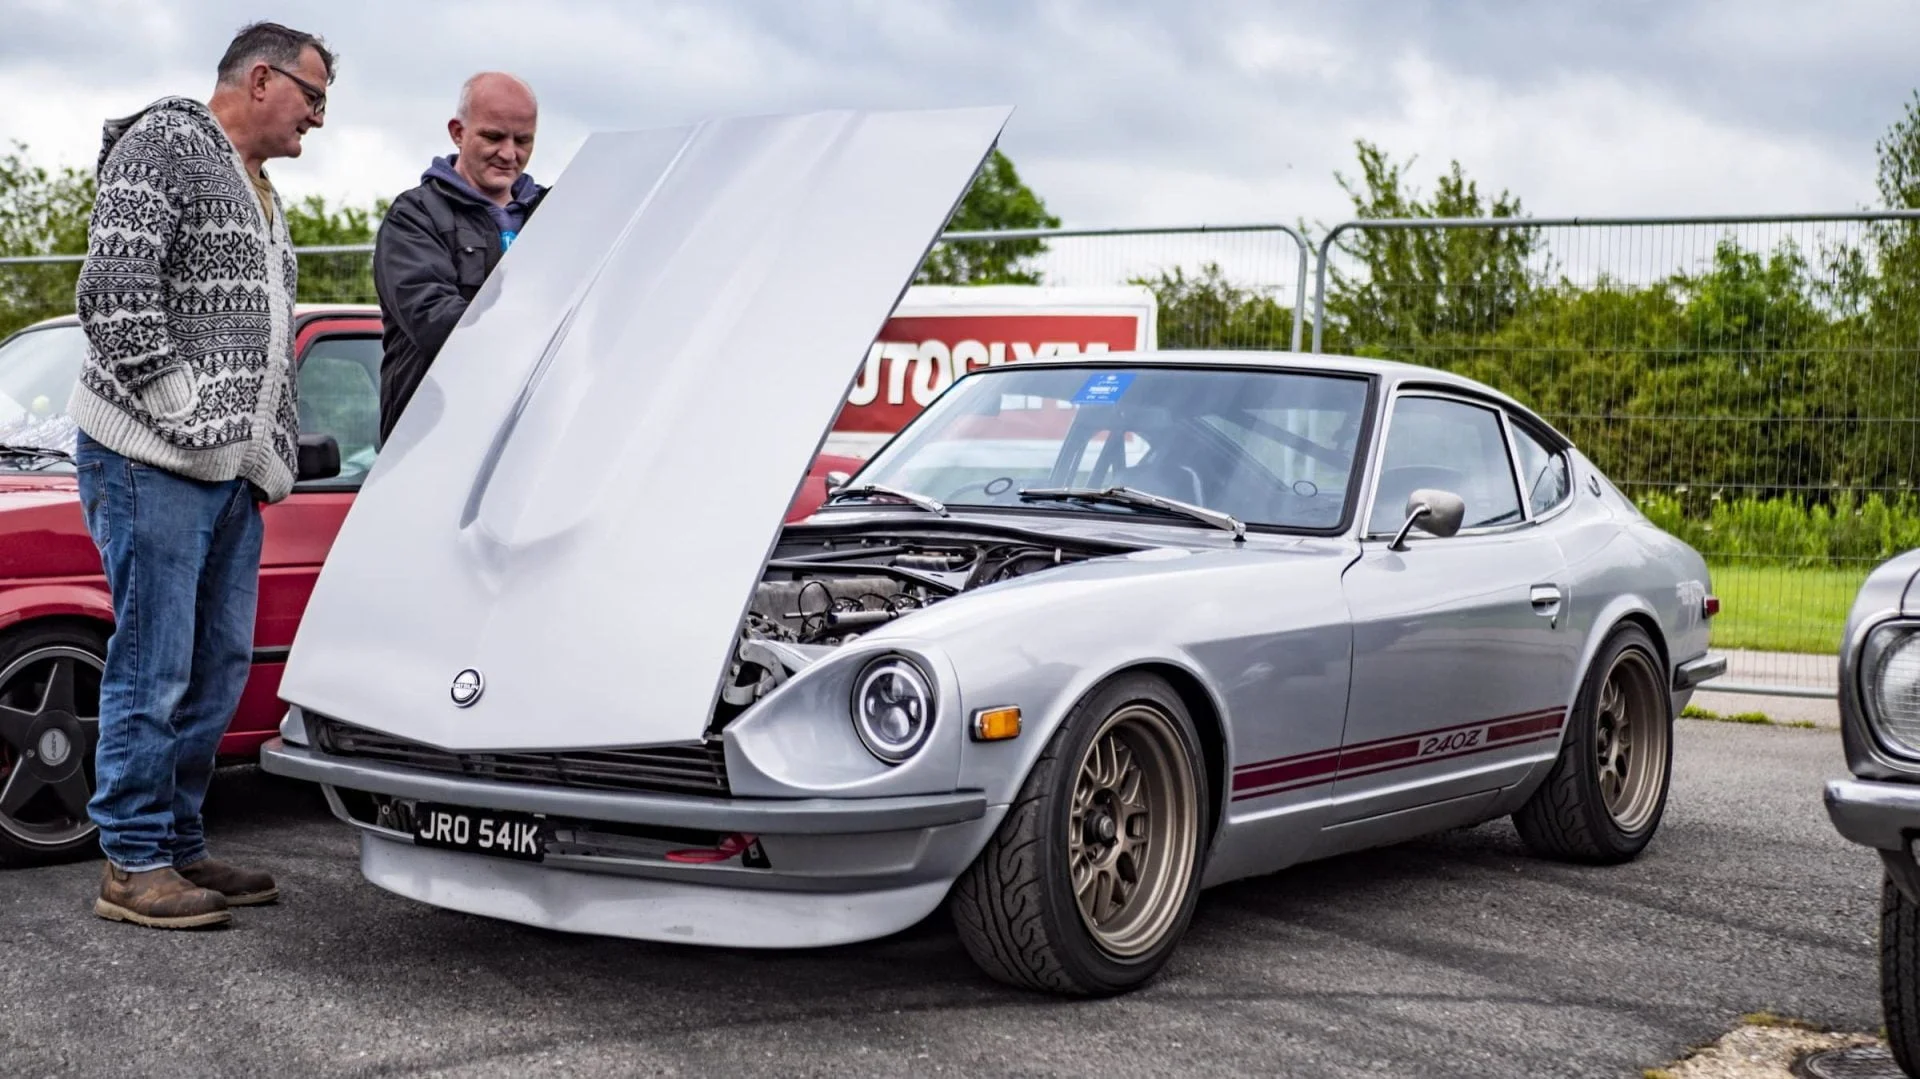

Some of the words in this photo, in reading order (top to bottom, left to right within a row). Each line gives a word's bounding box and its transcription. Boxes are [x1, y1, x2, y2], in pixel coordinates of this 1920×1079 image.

[1421, 730, 1482, 755] 240Z
[420, 811, 470, 844] JRO
[478, 819, 538, 854] 541K
